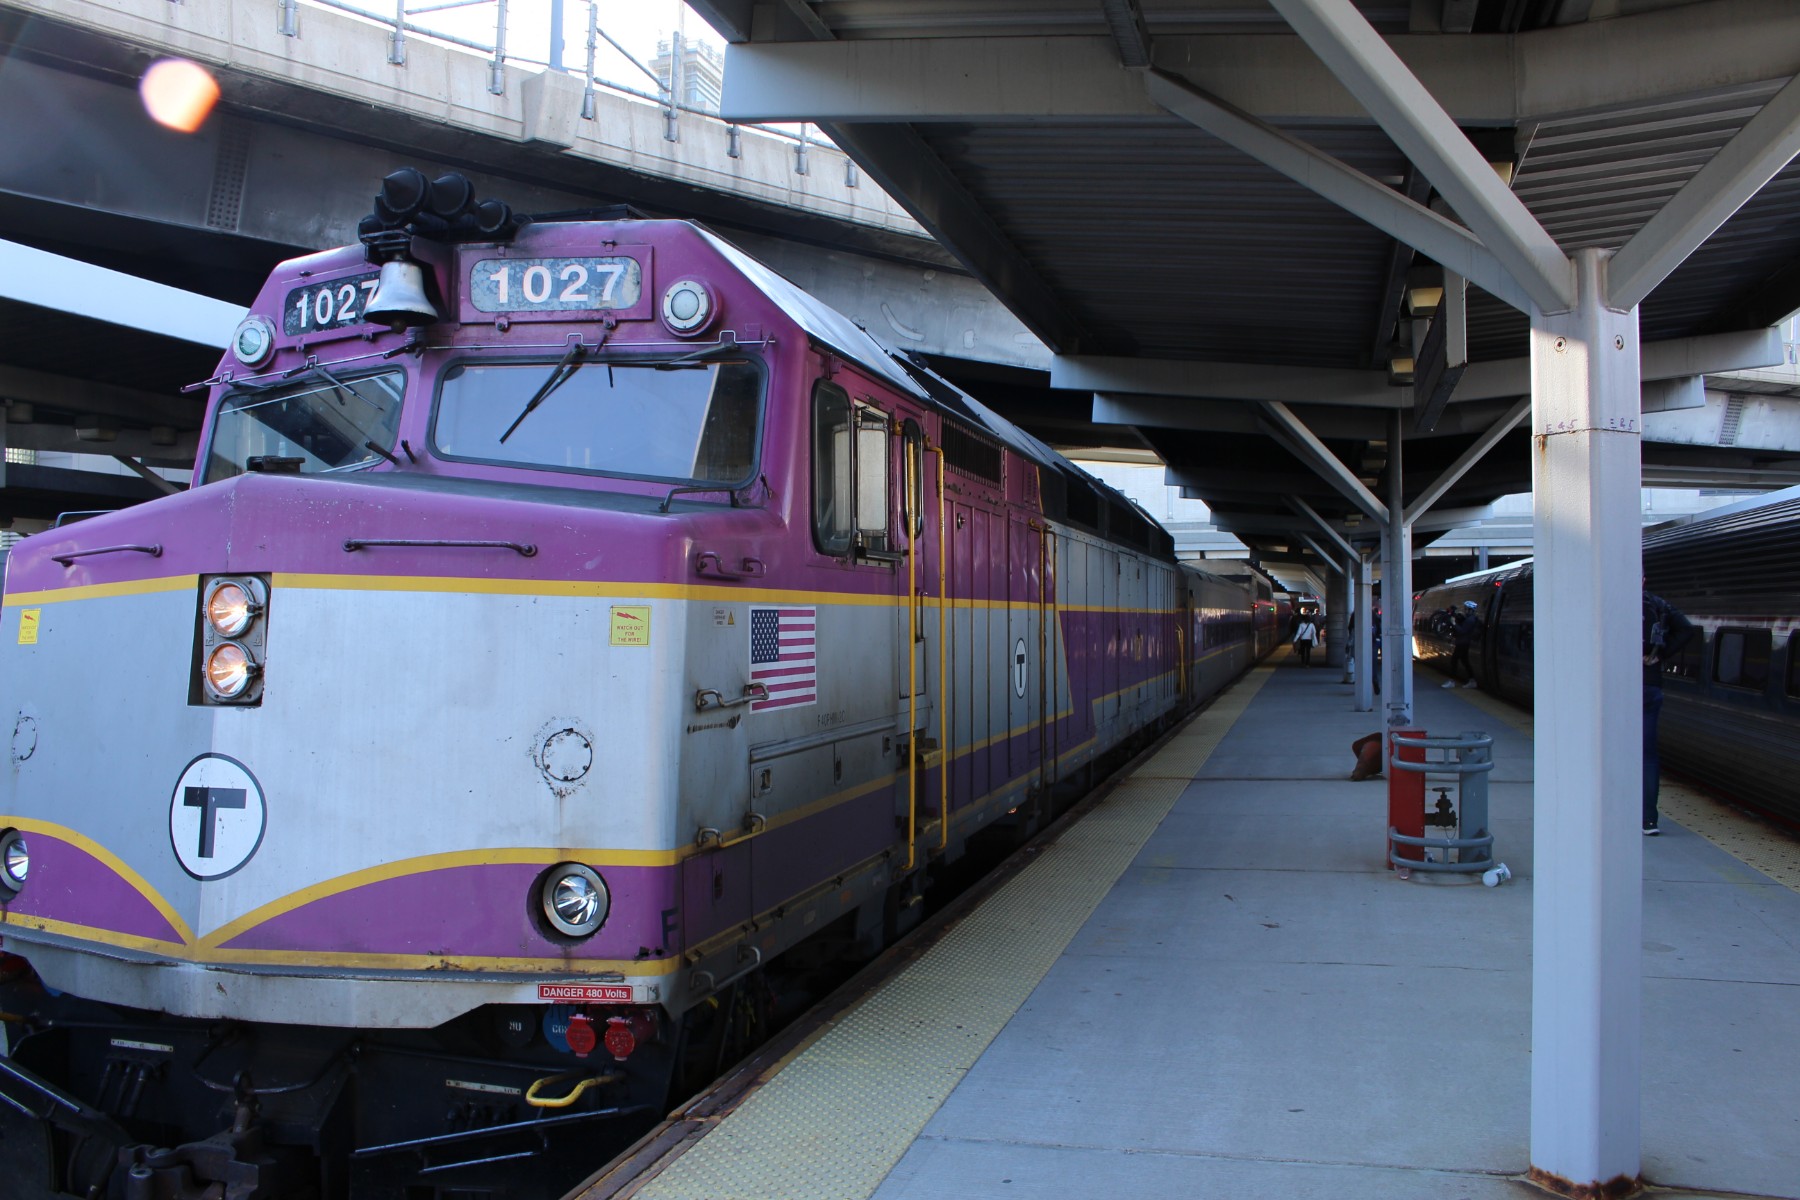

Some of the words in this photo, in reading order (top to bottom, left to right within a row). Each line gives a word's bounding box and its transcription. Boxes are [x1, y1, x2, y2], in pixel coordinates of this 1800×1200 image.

[296, 279, 380, 328] 1027
[490, 264, 624, 303] 1027
[1016, 654, 1024, 687] T
[183, 786, 247, 858] T
[661, 905, 679, 950] F
[543, 986, 584, 998] DANGER
[585, 987, 603, 999] 480
[604, 988, 628, 999] Volts
